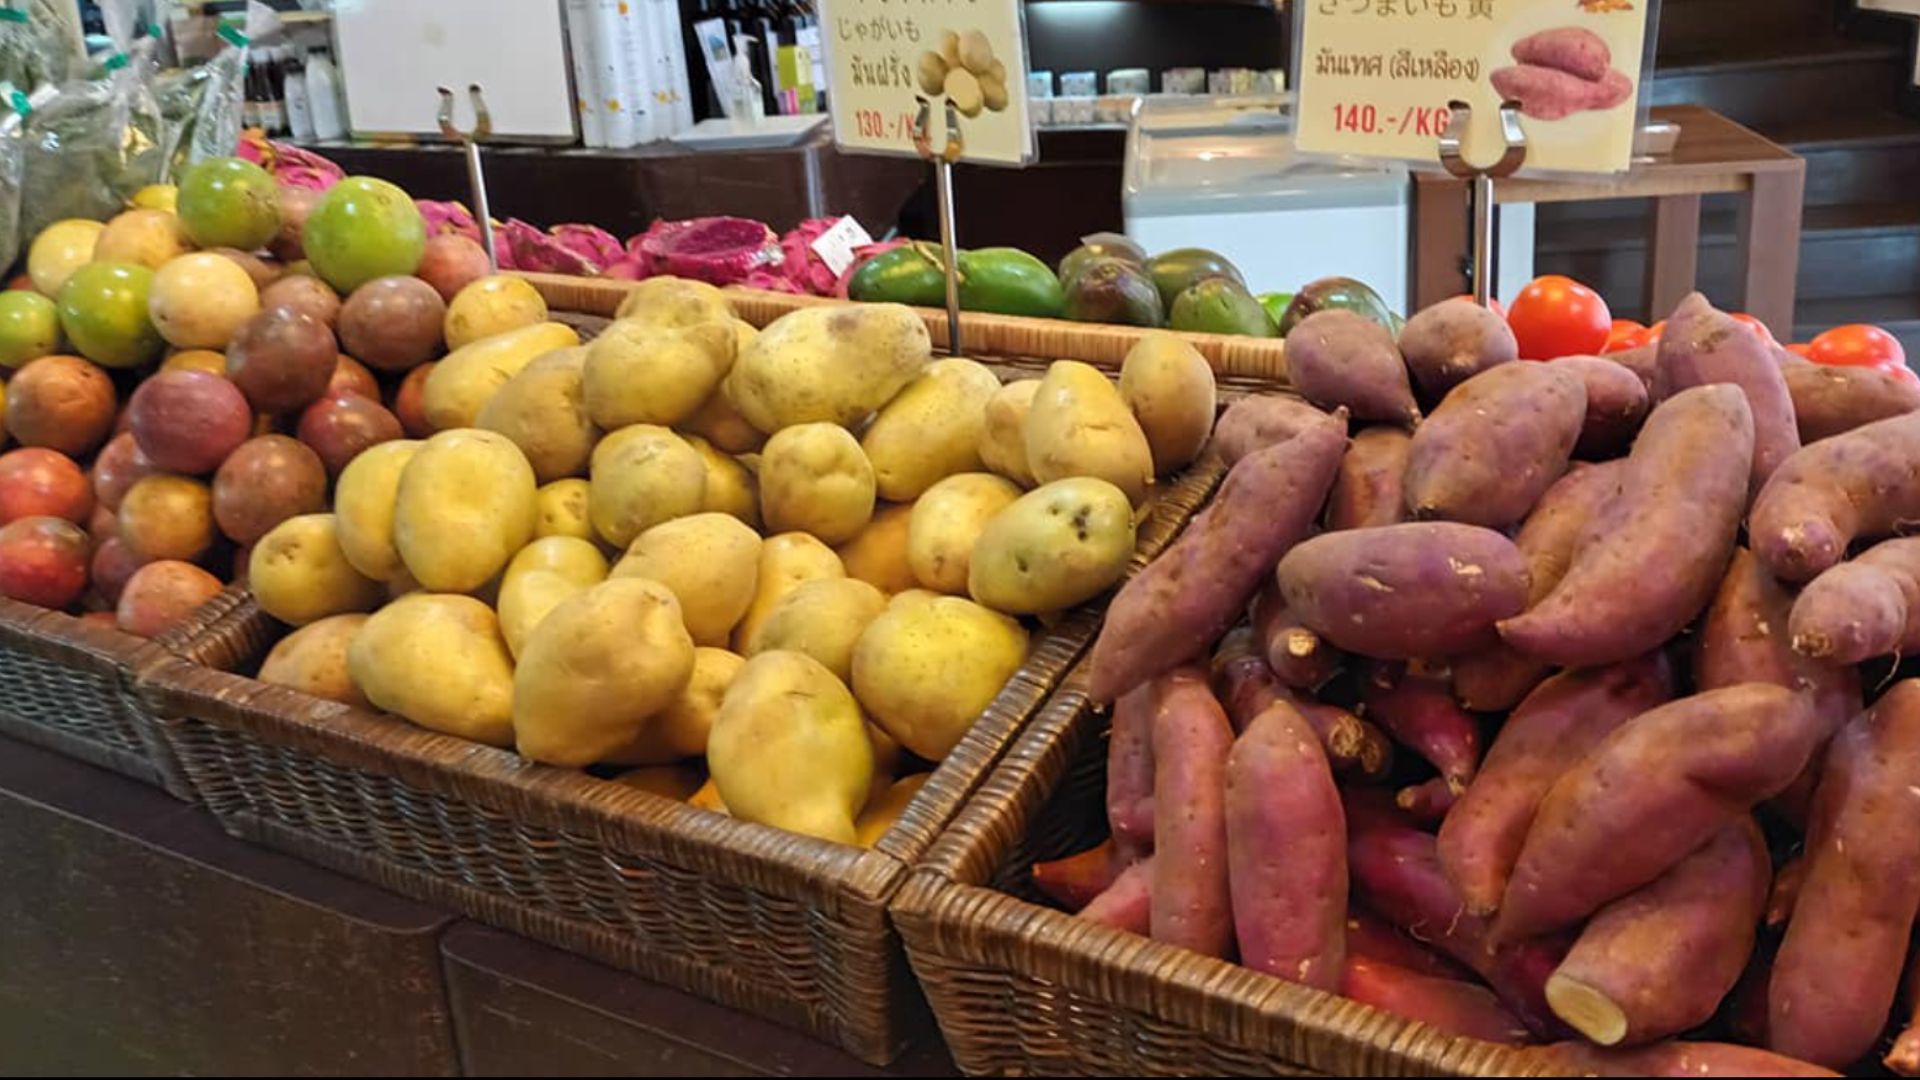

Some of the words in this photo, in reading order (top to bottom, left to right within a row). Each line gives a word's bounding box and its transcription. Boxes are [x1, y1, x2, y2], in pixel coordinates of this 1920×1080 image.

[838, 16, 920, 42] じゃがいも
[851, 52, 911, 87] มันฝรั่ง
[1317, 47, 1383, 77] มันเทศ
[1389, 50, 1480, 82] (สีเหลือง)
[856, 109, 927, 141] 130.-/K
